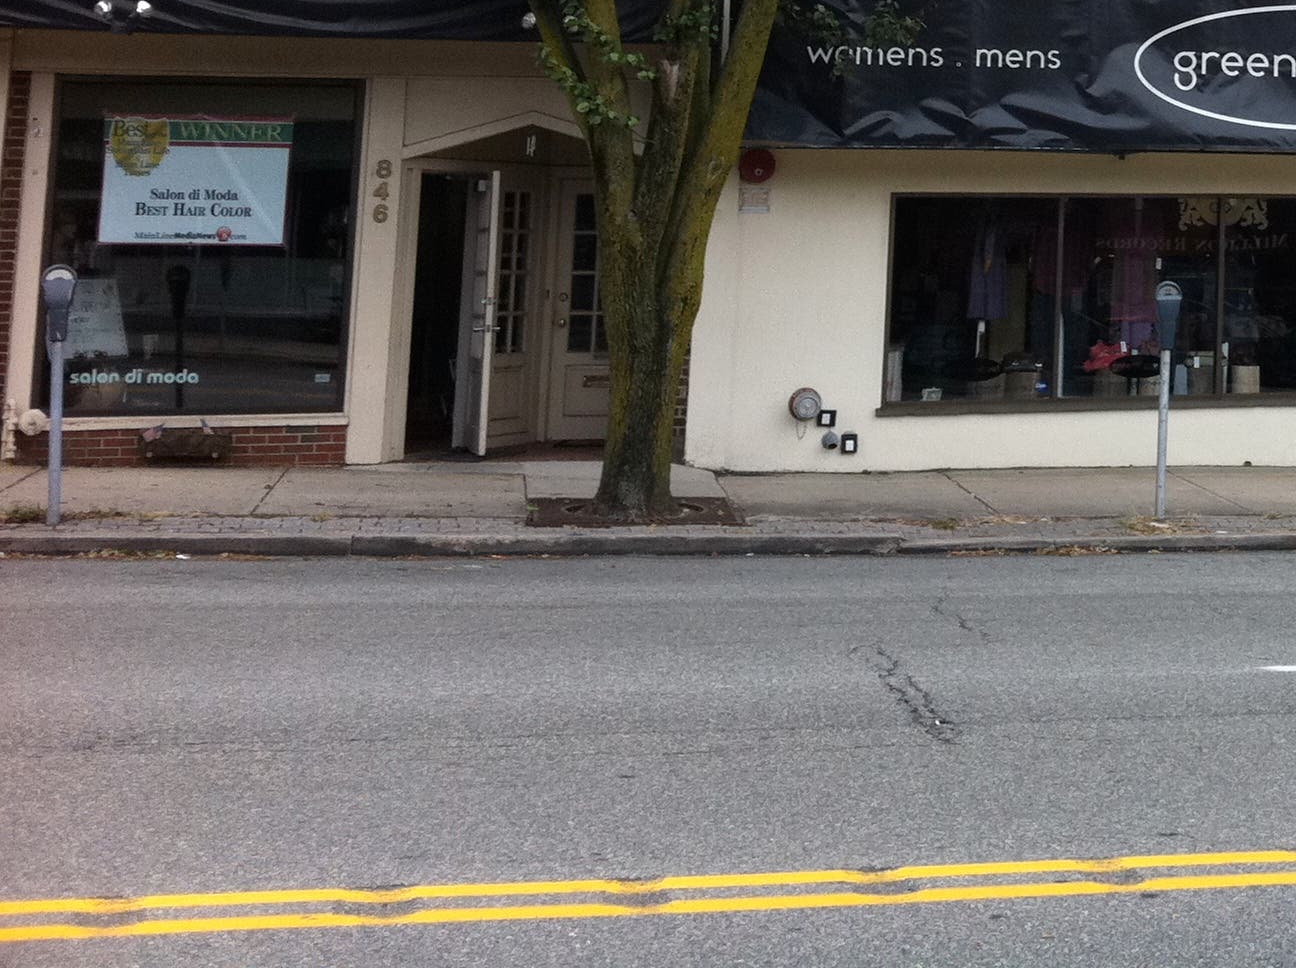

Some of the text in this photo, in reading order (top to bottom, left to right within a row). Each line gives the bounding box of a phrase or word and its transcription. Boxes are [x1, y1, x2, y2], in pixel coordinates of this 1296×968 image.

[807, 45, 944, 67] womens
[976, 48, 1061, 69] mens
[179, 122, 284, 142] WINNER
[150, 188, 238, 200] Salon di Moda
[373, 159, 393, 223] 846
[135, 202, 252, 217] BEST HAIR COLOR
[69, 368, 199, 384] salon di moda
